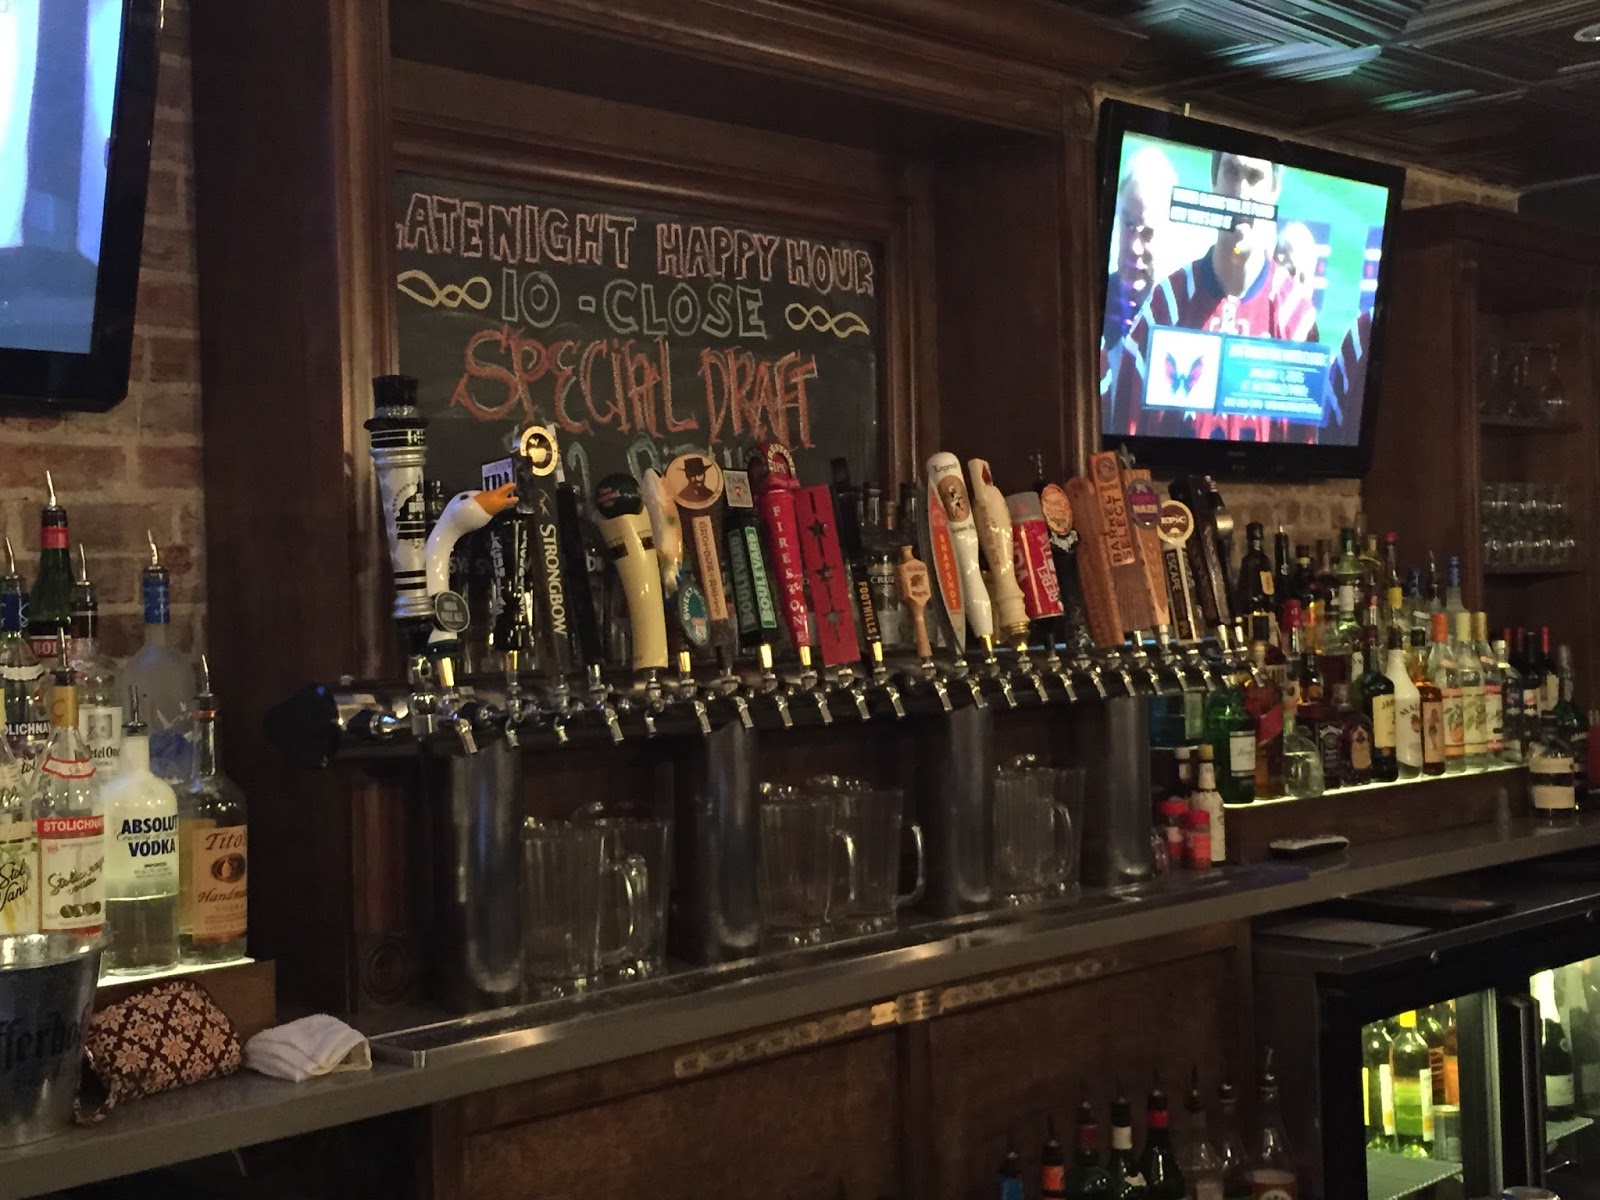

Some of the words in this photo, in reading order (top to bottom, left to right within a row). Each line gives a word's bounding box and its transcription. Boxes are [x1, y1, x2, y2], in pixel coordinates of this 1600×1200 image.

[656, 222, 778, 281] HAPPY
[786, 240, 875, 297] HOUR
[450, 325, 698, 438] SPECIAL
[698, 347, 820, 450] DRAFT
[539, 524, 568, 636] STRONGBOW
[746, 532, 773, 621] BOULEVARD
[772, 505, 807, 643] FIRESTONE
[858, 581, 878, 634] FOOTHILLS
[1037, 561, 1059, 602] REBEL
[121, 814, 178, 834] ABSOLUT
[128, 838, 176, 857] VODKA
